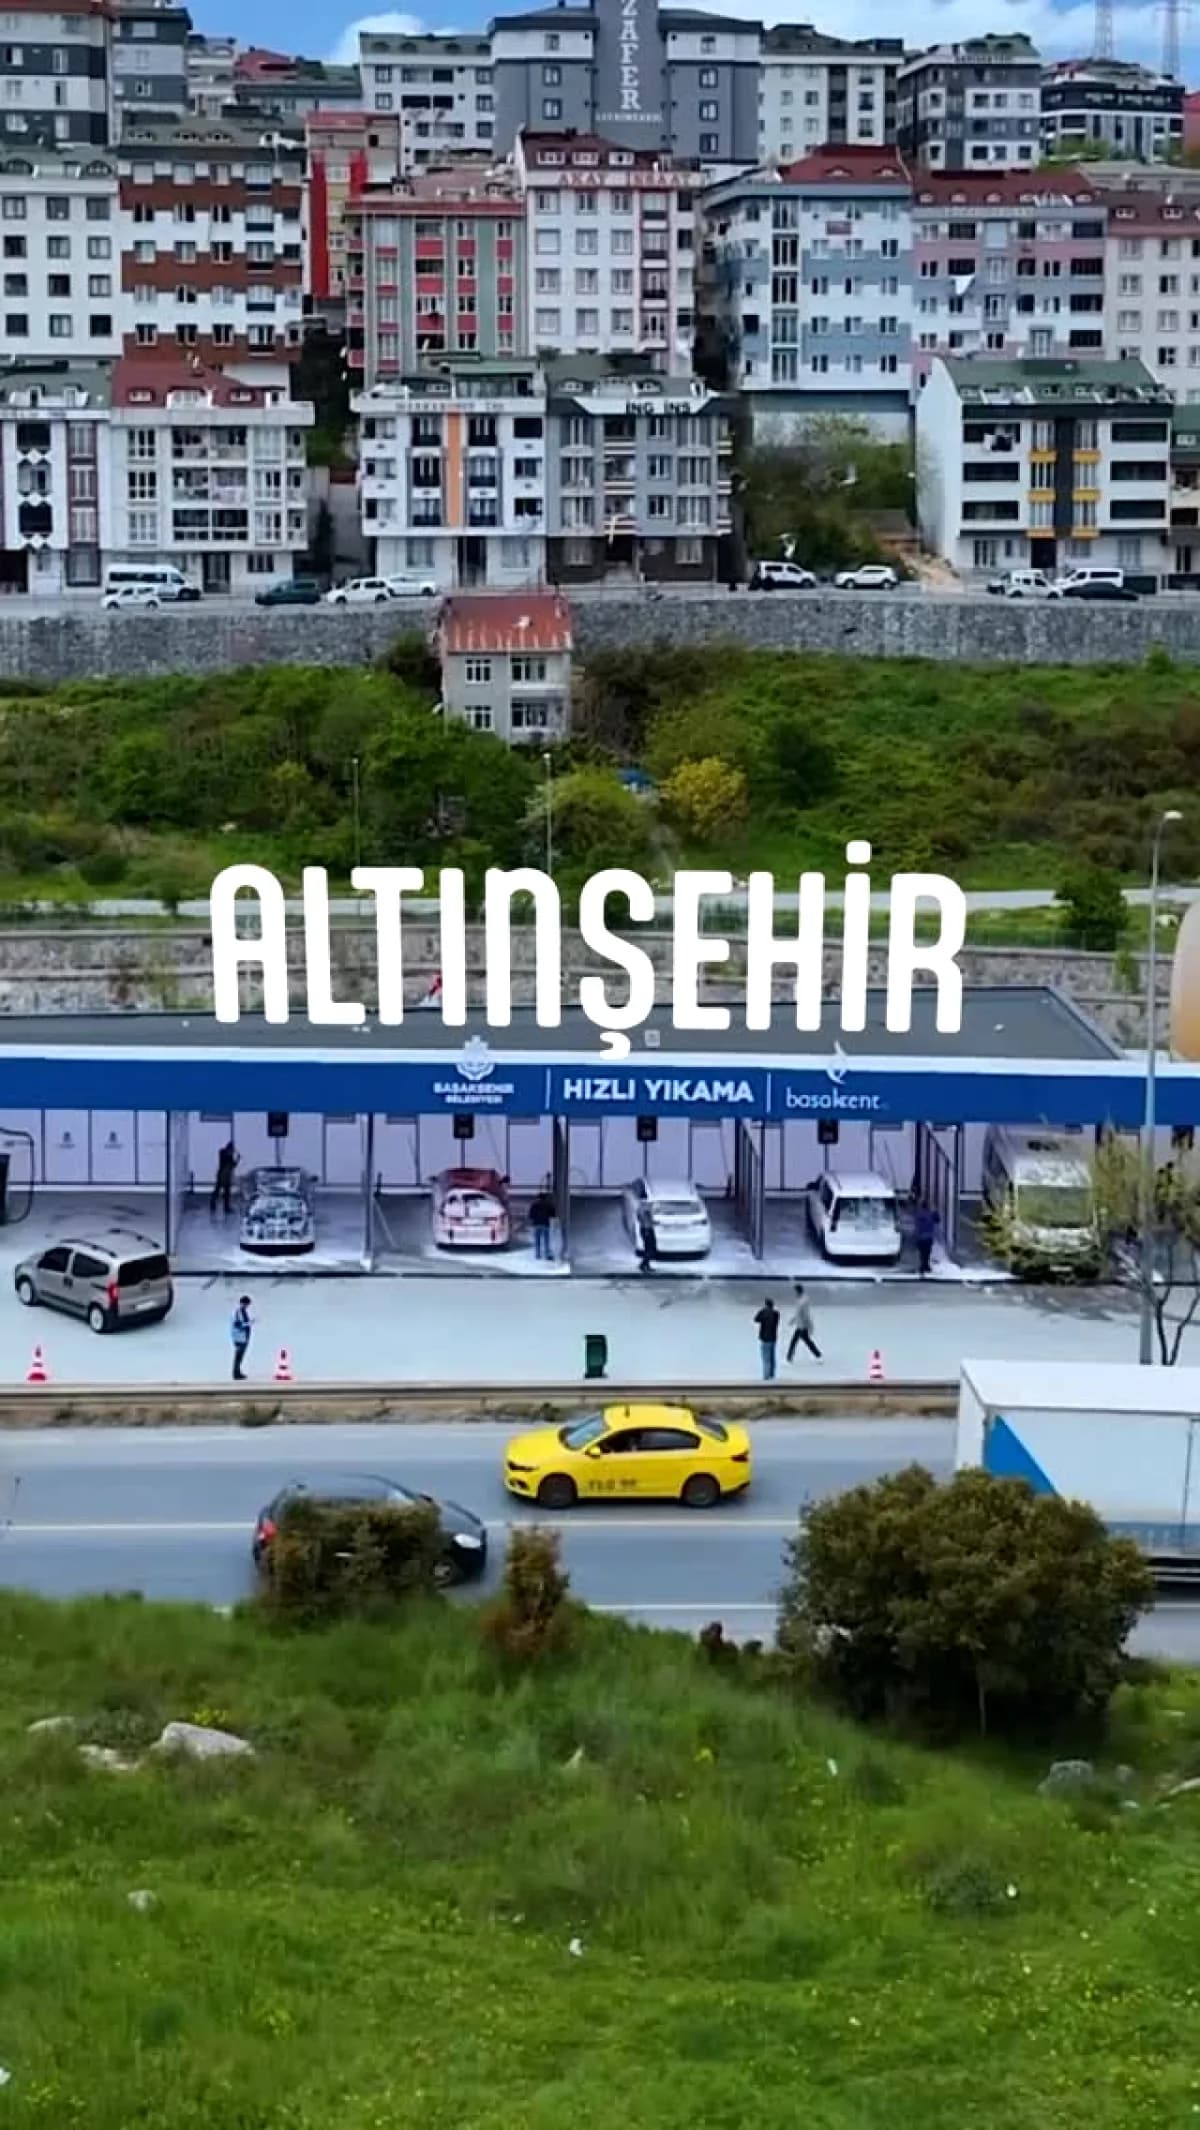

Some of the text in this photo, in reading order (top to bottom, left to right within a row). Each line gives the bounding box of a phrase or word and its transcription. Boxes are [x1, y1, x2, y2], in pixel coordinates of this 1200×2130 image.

[620, 0, 641, 110] ZAFER
[563, 1078, 754, 1102] HIZLI YIKAMA
